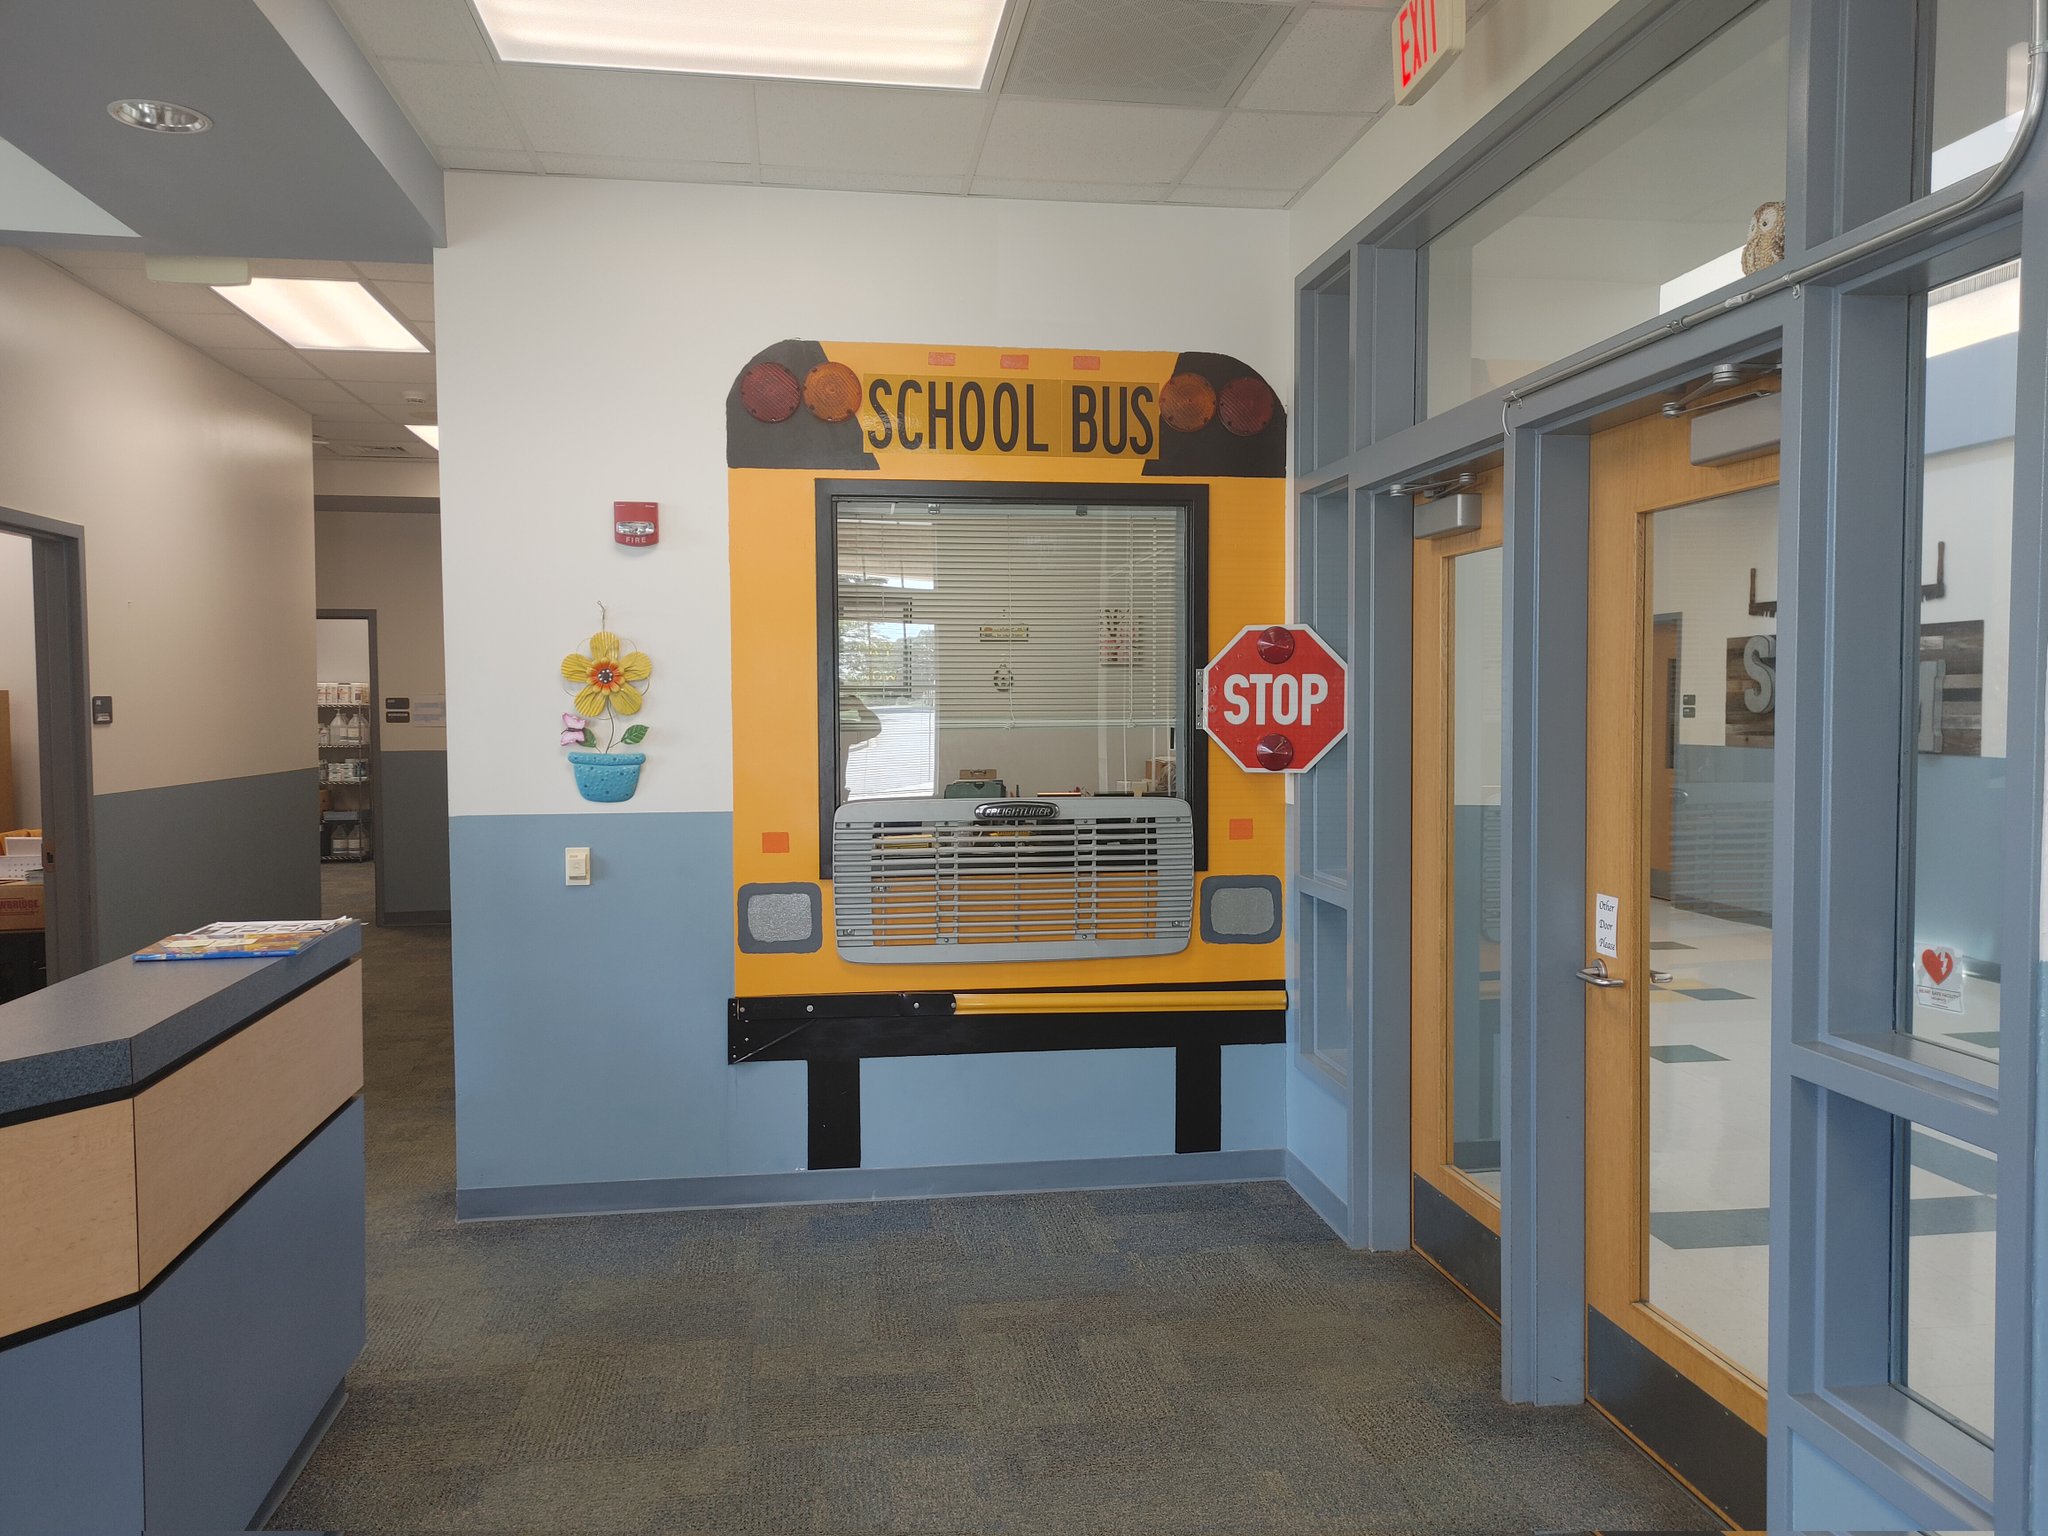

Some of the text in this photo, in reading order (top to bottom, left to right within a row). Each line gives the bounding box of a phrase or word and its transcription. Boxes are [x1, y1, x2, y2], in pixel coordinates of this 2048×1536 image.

[867, 377, 1155, 456] SCHOOL BUS
[1223, 673, 1329, 726] STOP
[985, 807, 1051, 816] FREIGHTLINER
[1599, 900, 1615, 912] Other
[1599, 919, 1613, 930] Door
[1599, 937, 1615, 950] Please
